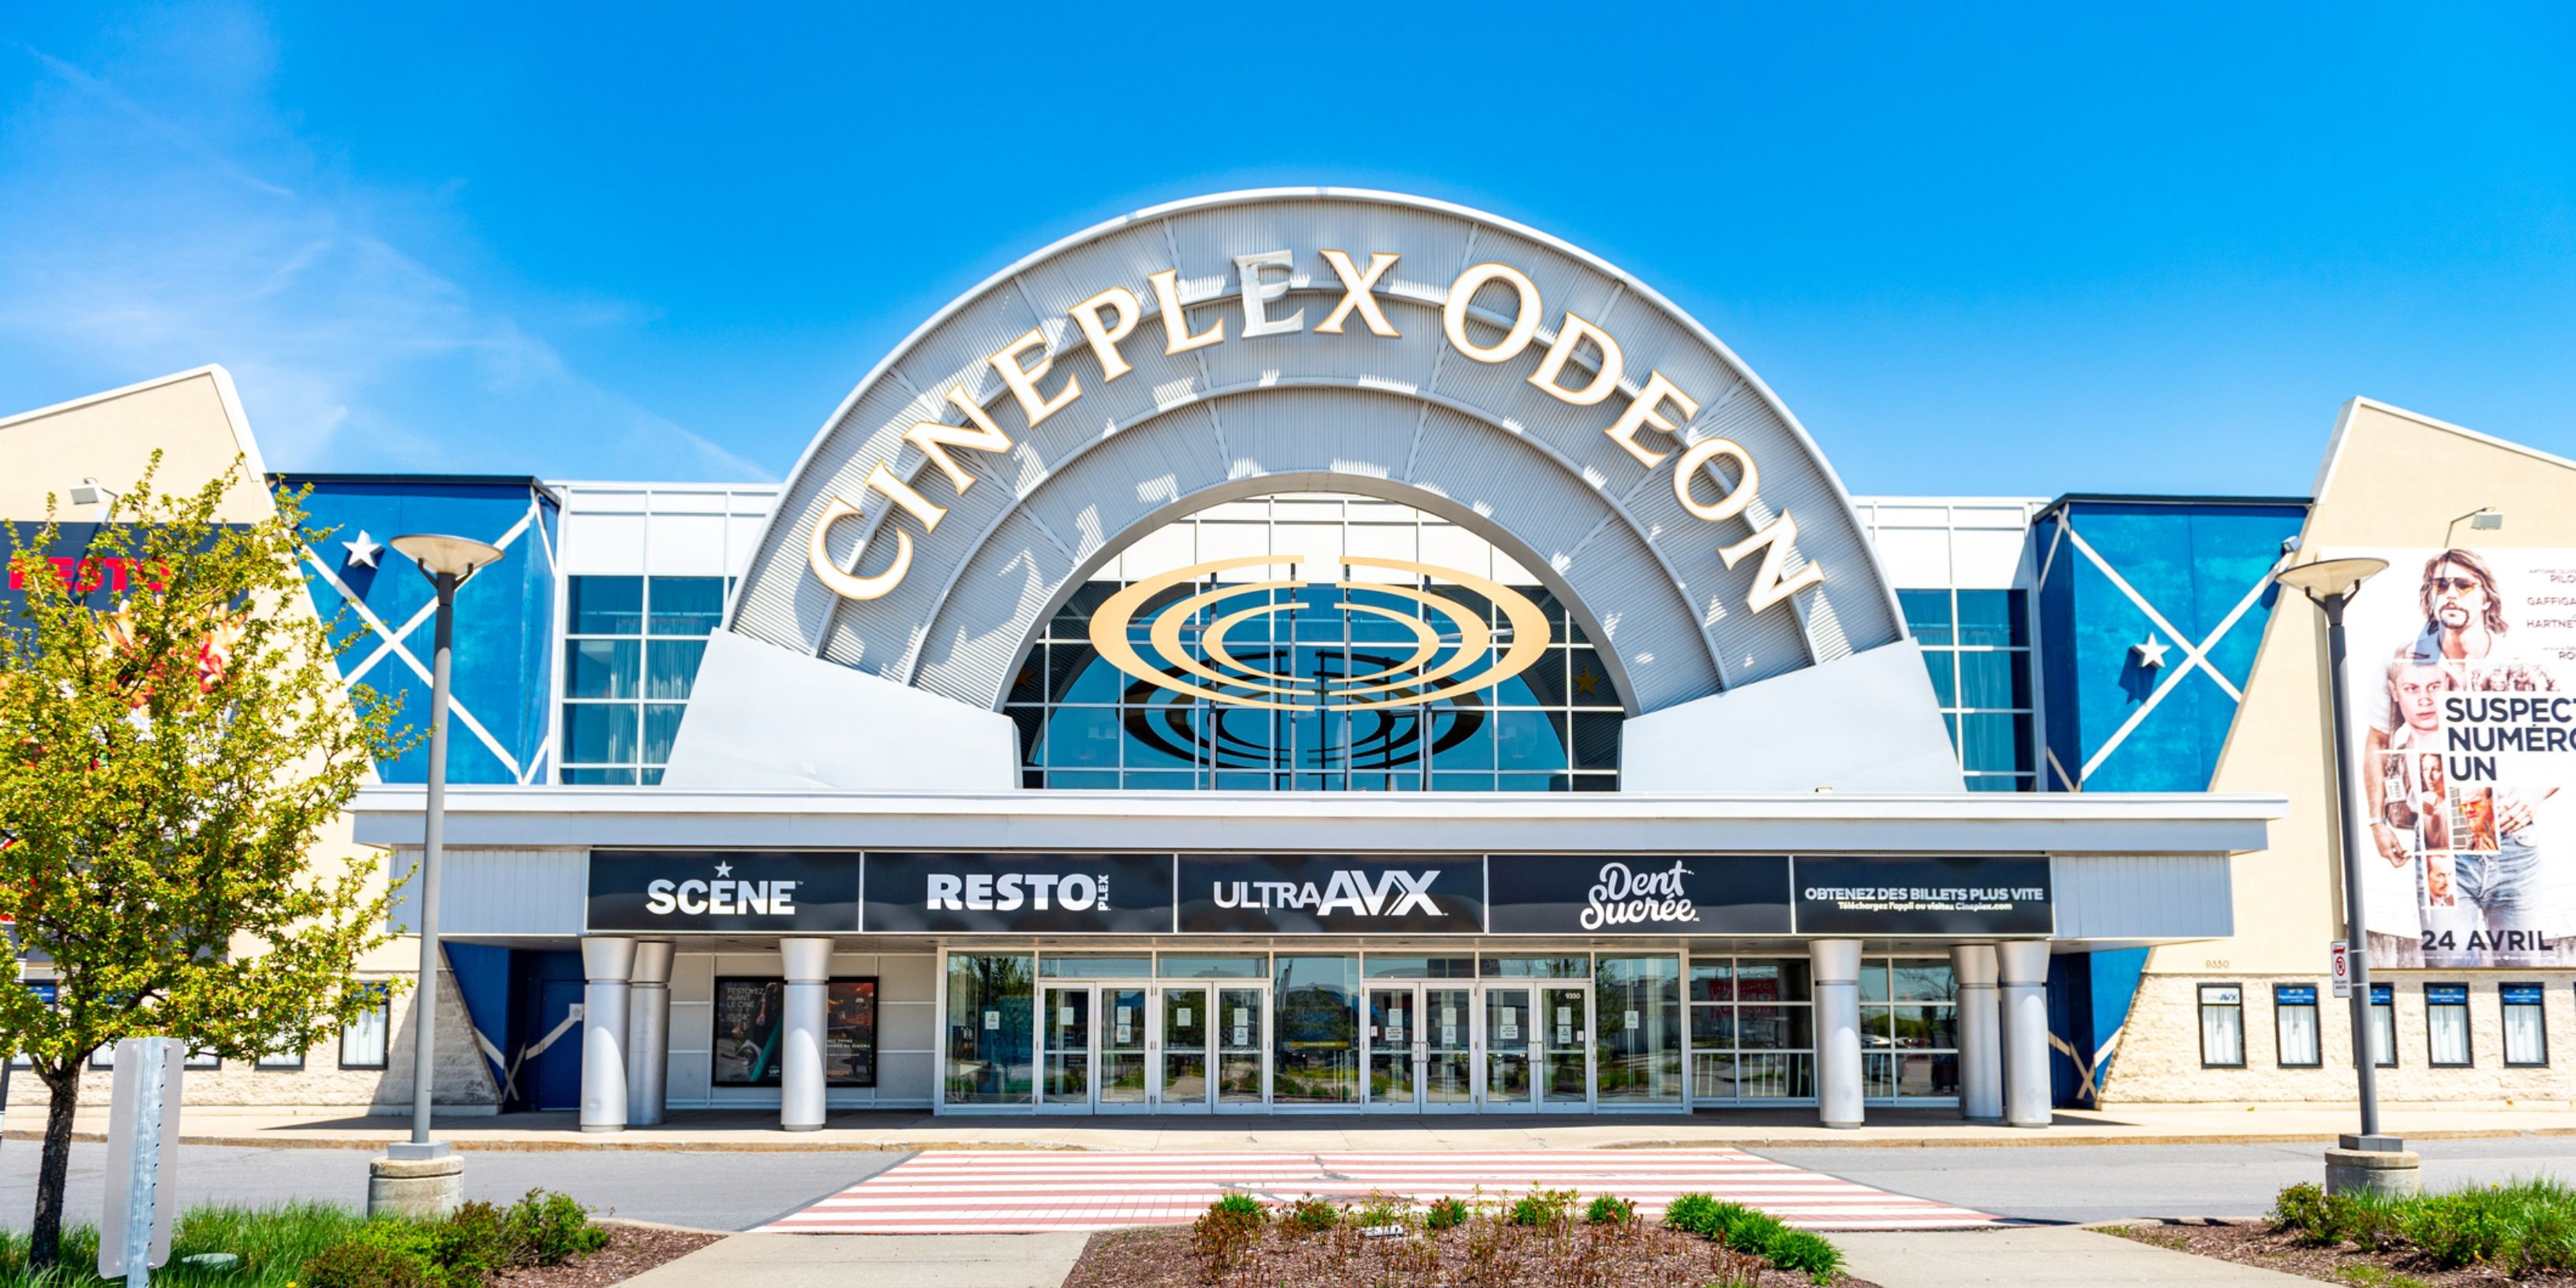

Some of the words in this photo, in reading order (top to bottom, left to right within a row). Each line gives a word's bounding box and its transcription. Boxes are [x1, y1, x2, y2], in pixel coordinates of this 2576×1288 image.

[808, 249, 1403, 601] CINEPLEX
[1443, 261, 1827, 615] ODEON
[2559, 651, 2576, 660] RO
[2450, 756, 2497, 781] UN
[927, 873, 1098, 912] RESTO
[1098, 874, 1111, 912] PLEX
[1599, 859, 1694, 901] Dent
[1804, 887, 1877, 900] OBTENEZ
[1878, 887, 1908, 900] DES
[1910, 887, 1968, 900] BILLETS
[1969, 887, 2009, 900] PLUS
[2010, 887, 2044, 900] VITE
[1580, 884, 1696, 930] Sucrée
[1837, 901, 1889, 912] Téléchargez
[1927, 902, 1954, 911] visitez
[1955, 902, 2012, 912] Cineplex.com
[2421, 930, 2457, 951] 24
[2466, 930, 2553, 951] AVRIL
